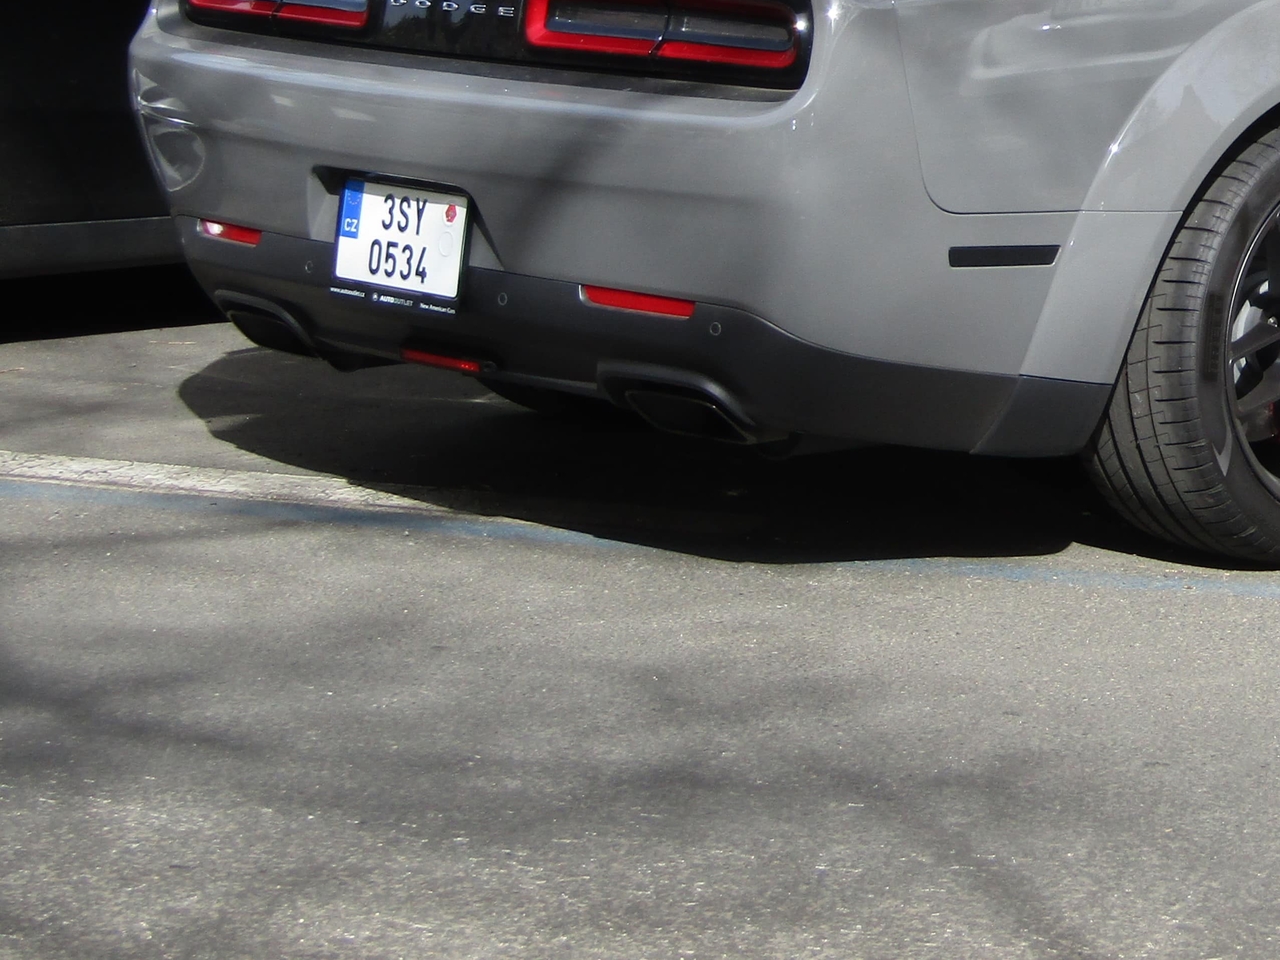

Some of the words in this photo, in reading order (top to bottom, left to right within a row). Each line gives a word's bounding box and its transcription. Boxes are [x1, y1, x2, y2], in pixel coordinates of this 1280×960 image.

[343, 217, 359, 233] CZ
[381, 193, 428, 236] 3SY
[368, 238, 428, 285] 0534
